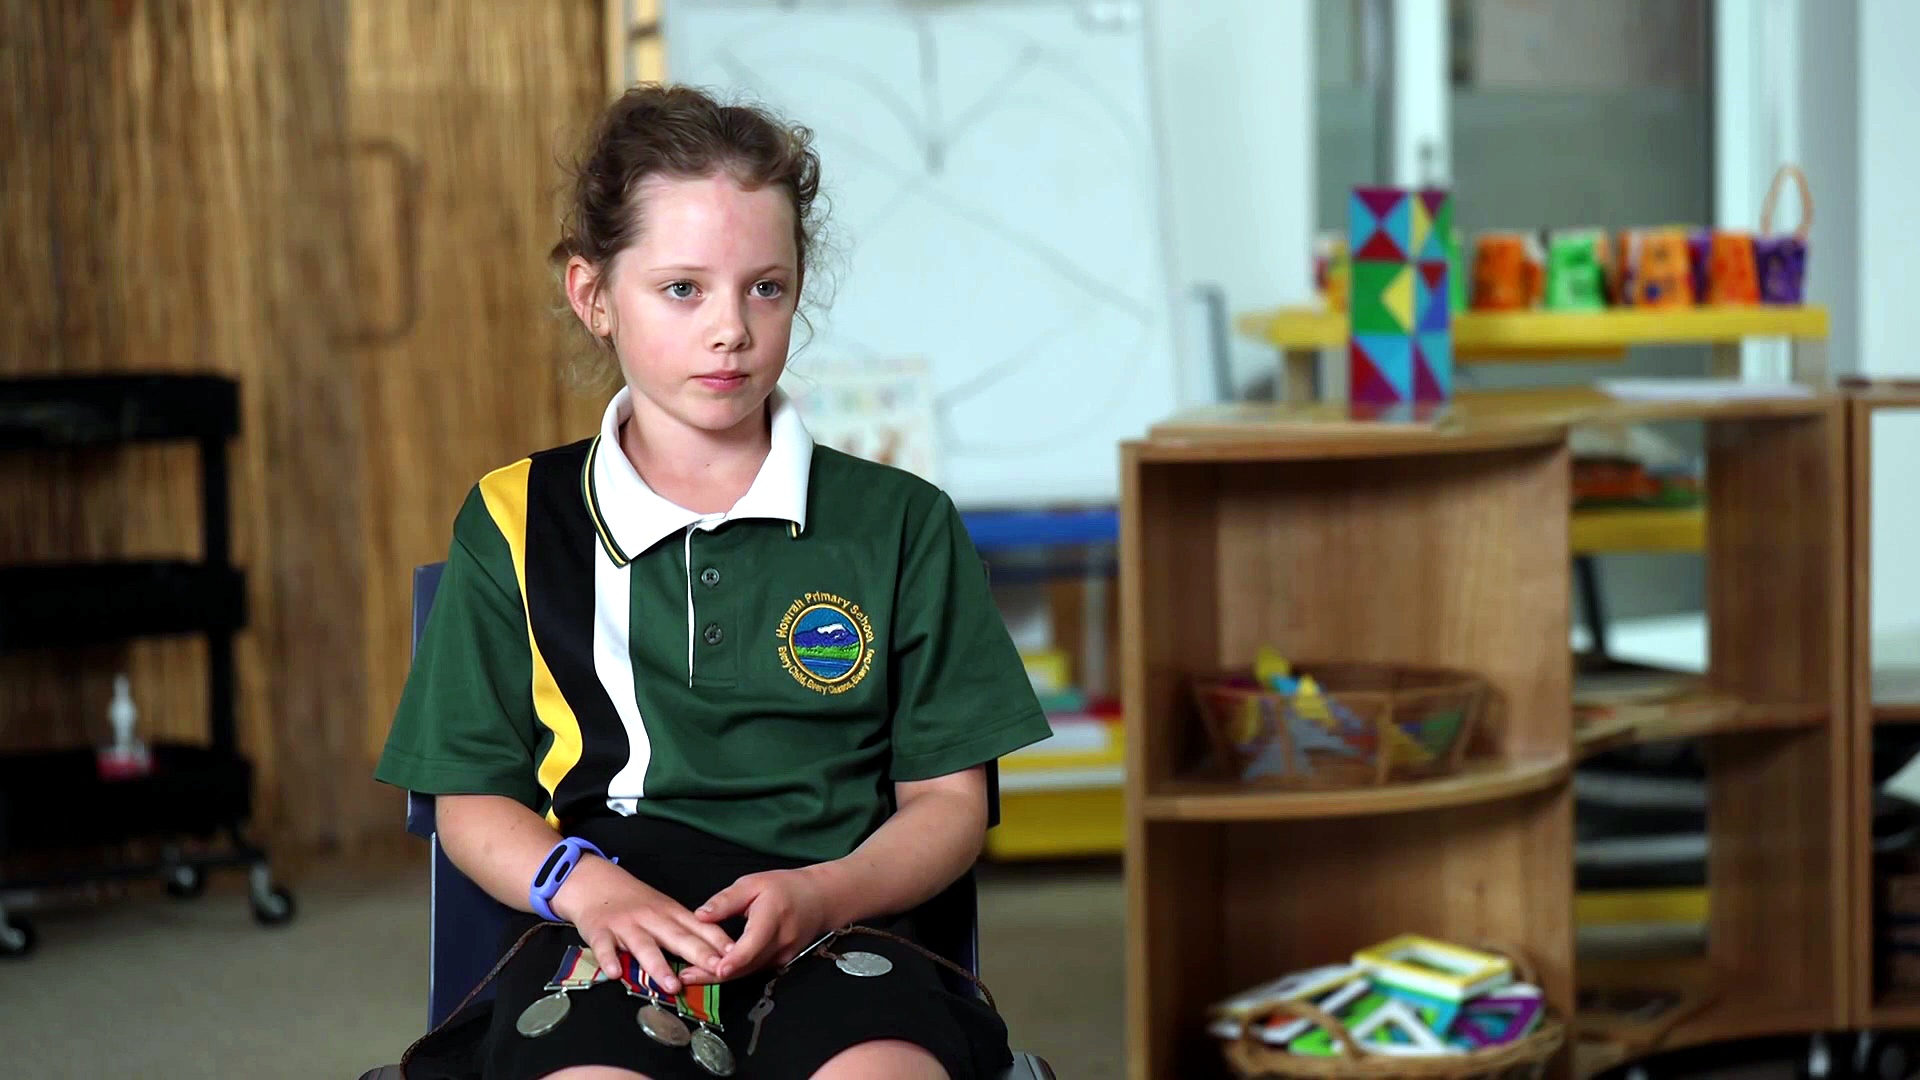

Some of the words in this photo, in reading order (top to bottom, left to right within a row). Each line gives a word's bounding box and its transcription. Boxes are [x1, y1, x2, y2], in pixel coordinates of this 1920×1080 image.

[776, 599, 805, 638] Howrah
[804, 591, 851, 608] Primary
[850, 605, 875, 643] School
